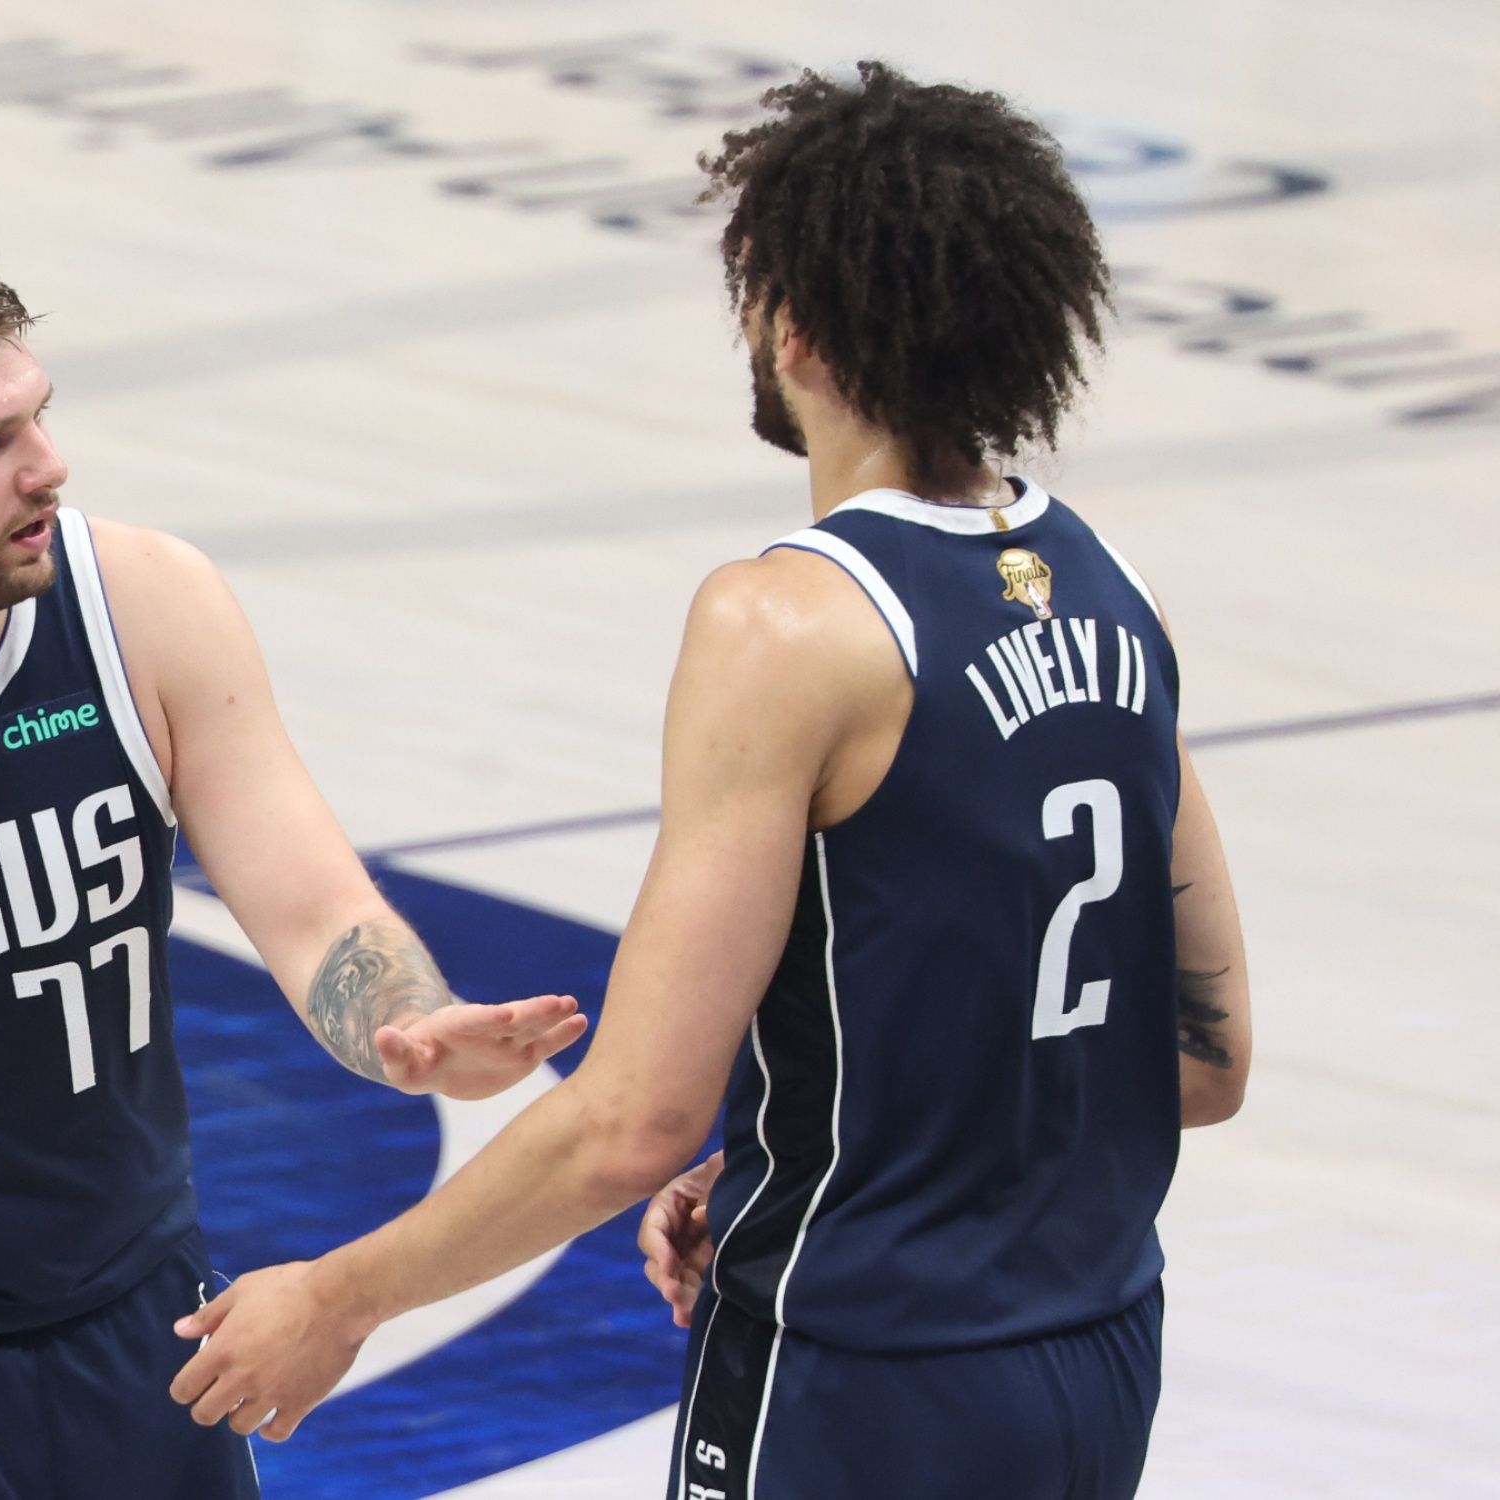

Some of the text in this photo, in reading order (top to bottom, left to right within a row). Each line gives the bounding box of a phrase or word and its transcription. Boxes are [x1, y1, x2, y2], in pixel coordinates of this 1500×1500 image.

[3, 703, 100, 750] chime
[964, 617, 1146, 741] LIVELY II
[1031, 778, 1124, 1040] 2
[11, 926, 151, 1094] 77
